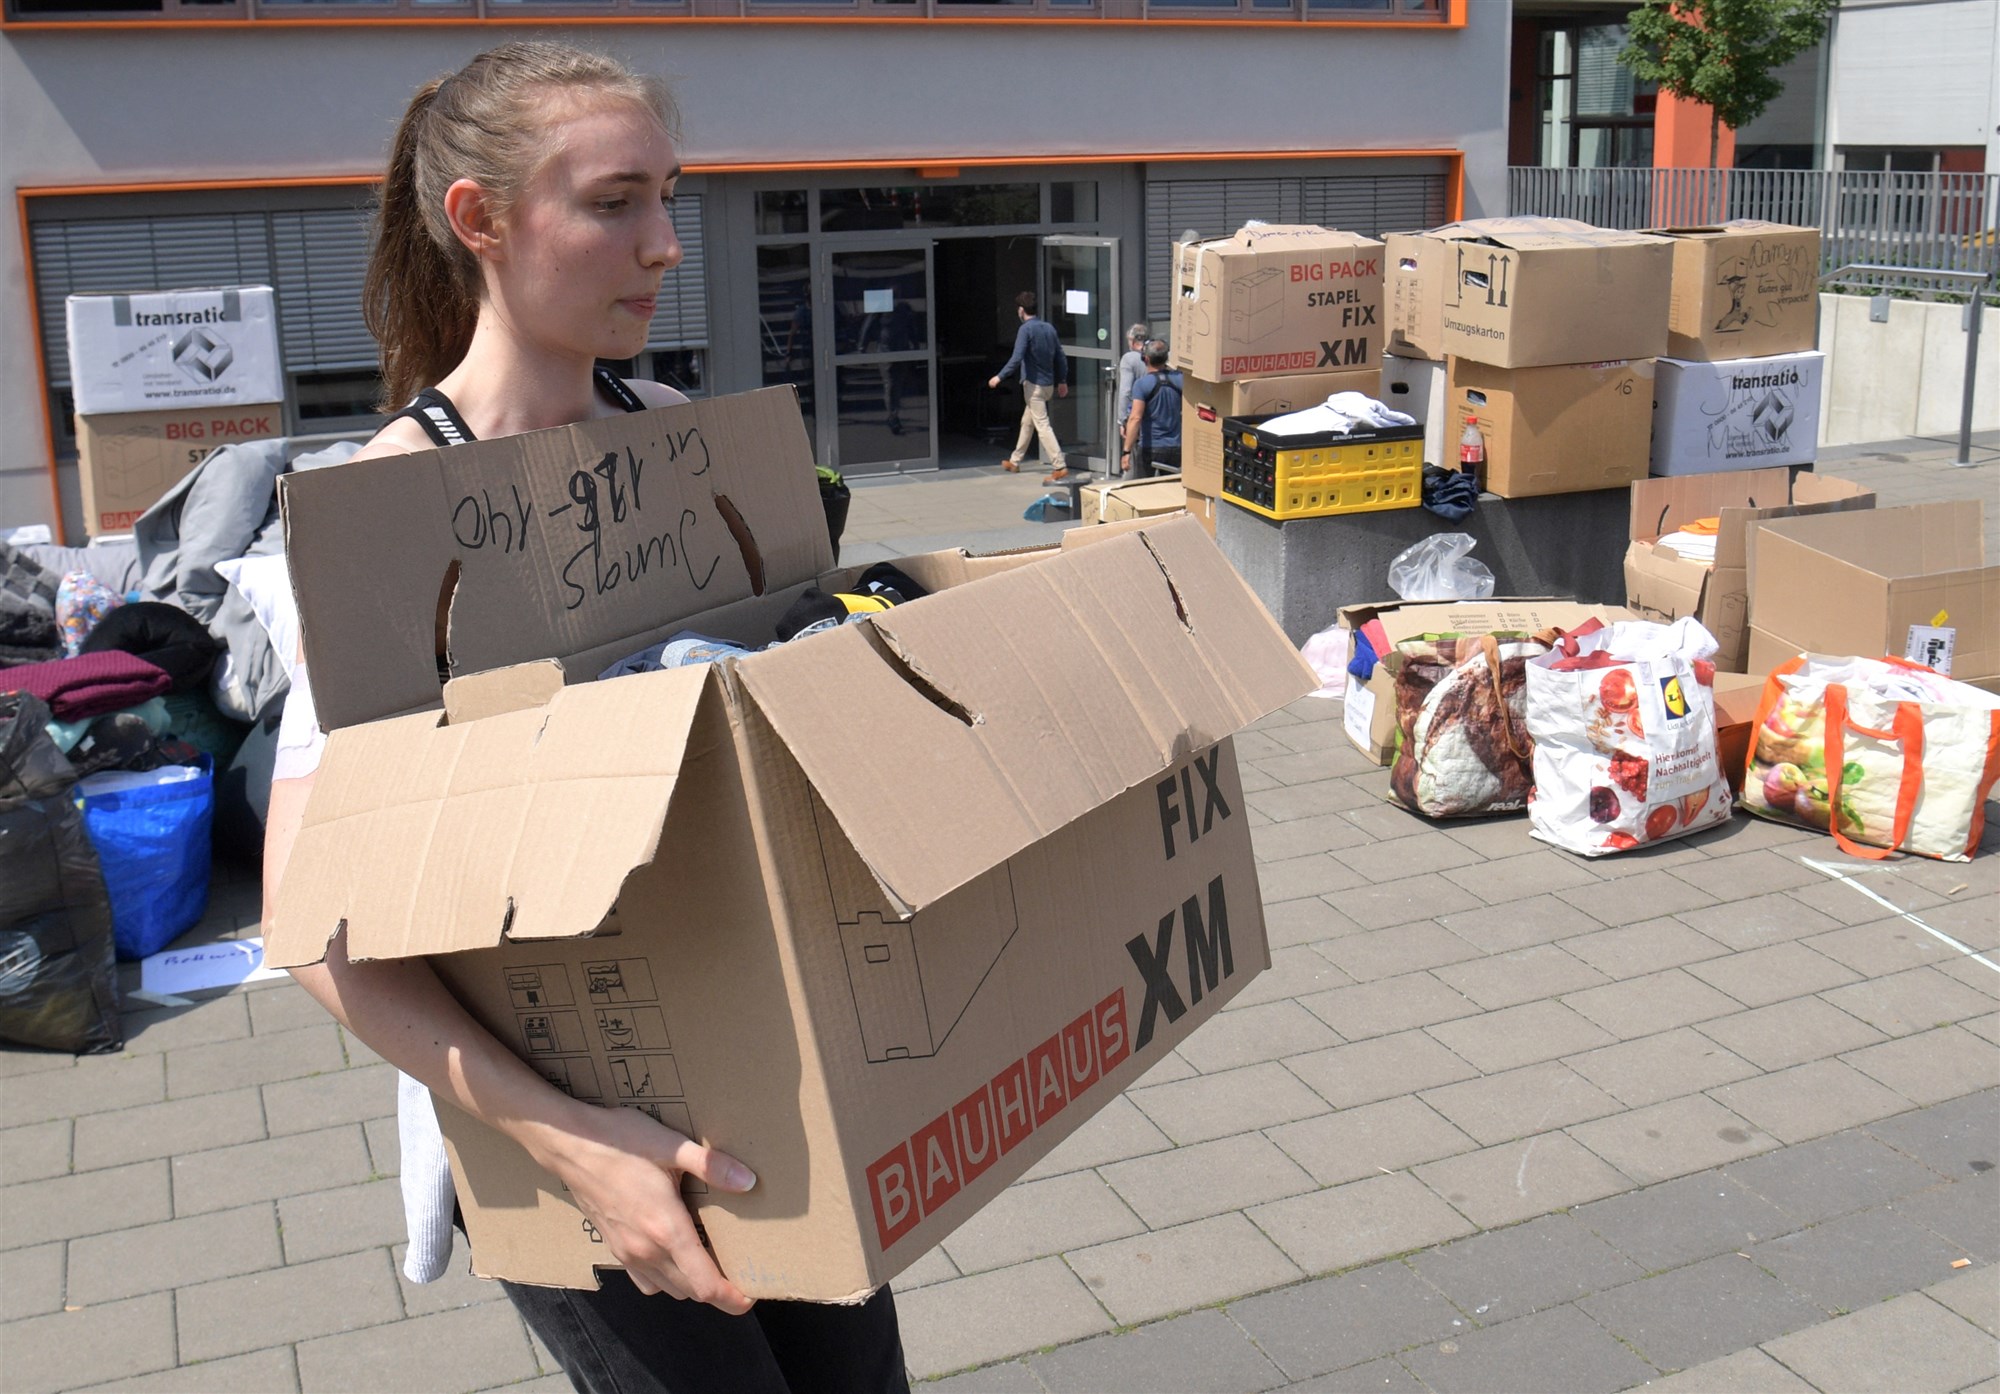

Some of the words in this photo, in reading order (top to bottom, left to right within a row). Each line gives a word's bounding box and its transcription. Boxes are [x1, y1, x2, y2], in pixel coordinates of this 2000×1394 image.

[1290, 263, 1323, 282] BIG
[1329, 259, 1377, 279] PACK
[1307, 289, 1361, 307] STAPEL
[1342, 305, 1376, 328] FIX
[1444, 317, 1505, 340] Umzugskarton
[1222, 352, 1316, 375] BAUHAUS
[1316, 337, 1368, 368] XM
[1614, 378, 1634, 396] 16
[1732, 368, 1799, 390] transratio
[165, 421, 205, 440] BIG
[211, 417, 272, 437] PACK
[188, 448, 211, 464] ST
[1726, 446, 1790, 459] www.transratio.de
[562, 506, 721, 609] Jungs
[1655, 752, 1675, 764] Hier
[1156, 744, 1231, 860] FIX
[1124, 873, 1235, 1054] XM
[872, 994, 1128, 1240] BAUHAUS
